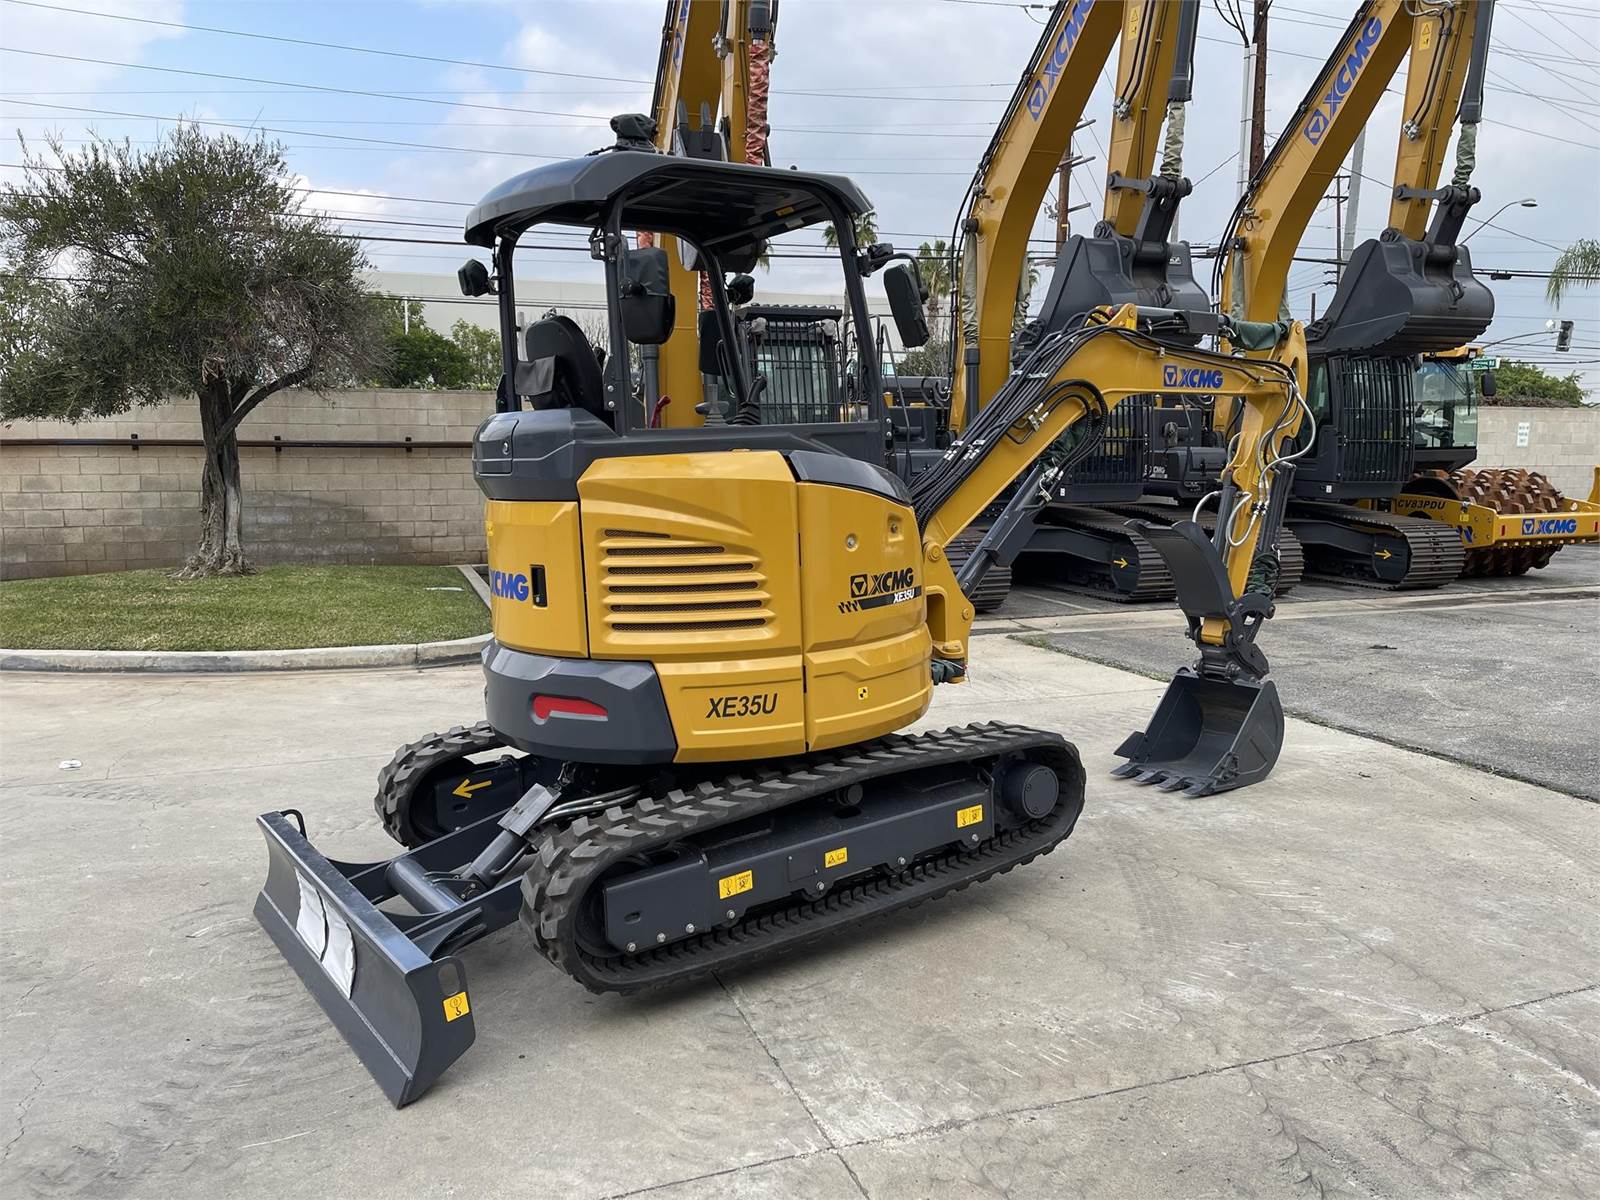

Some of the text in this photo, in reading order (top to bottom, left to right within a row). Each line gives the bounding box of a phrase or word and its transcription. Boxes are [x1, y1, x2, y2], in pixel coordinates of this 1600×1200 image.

[1323, 16, 1382, 120] XCMG
[1177, 368, 1224, 389] XCMG
[1535, 518, 1577, 535] XCMG
[868, 567, 914, 596] XCMG
[893, 588, 915, 604] XE35U
[706, 692, 778, 719] XE35U
